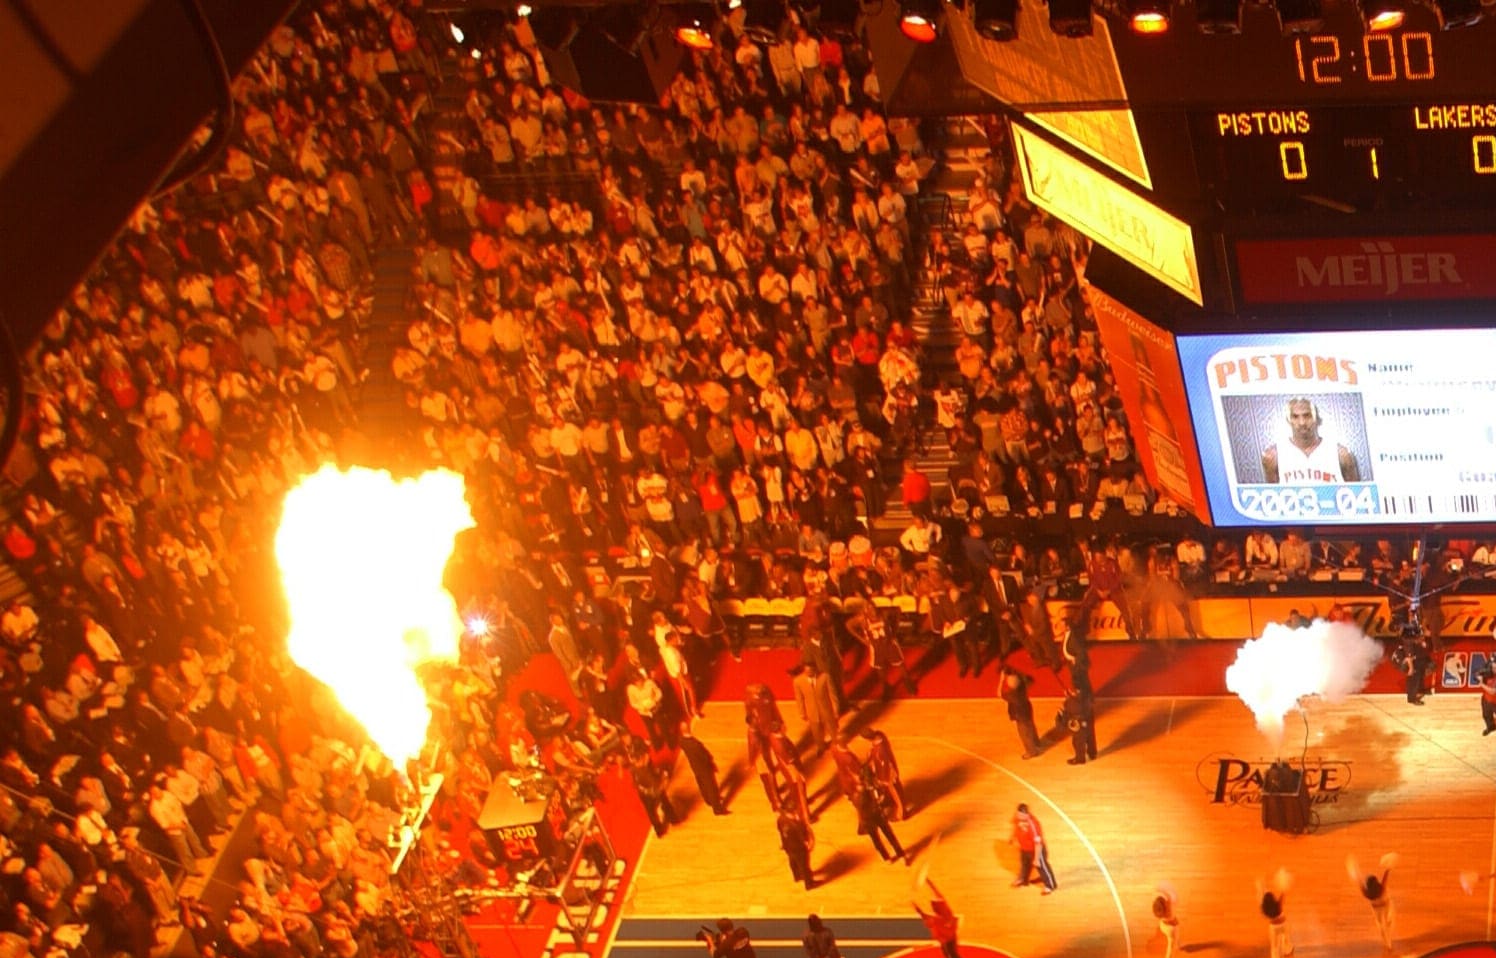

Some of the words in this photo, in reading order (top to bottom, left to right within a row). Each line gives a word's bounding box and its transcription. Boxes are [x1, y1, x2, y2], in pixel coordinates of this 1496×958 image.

[1295, 32, 1435, 83] 12:00
[1218, 111, 1311, 136] PISTONS
[1280, 141, 1308, 180] 0
[1371, 148, 1379, 180] 1
[1214, 354, 1358, 389] PISTONS
[1239, 486, 1376, 517] 2003-04
[497, 825, 537, 841] 12:00
